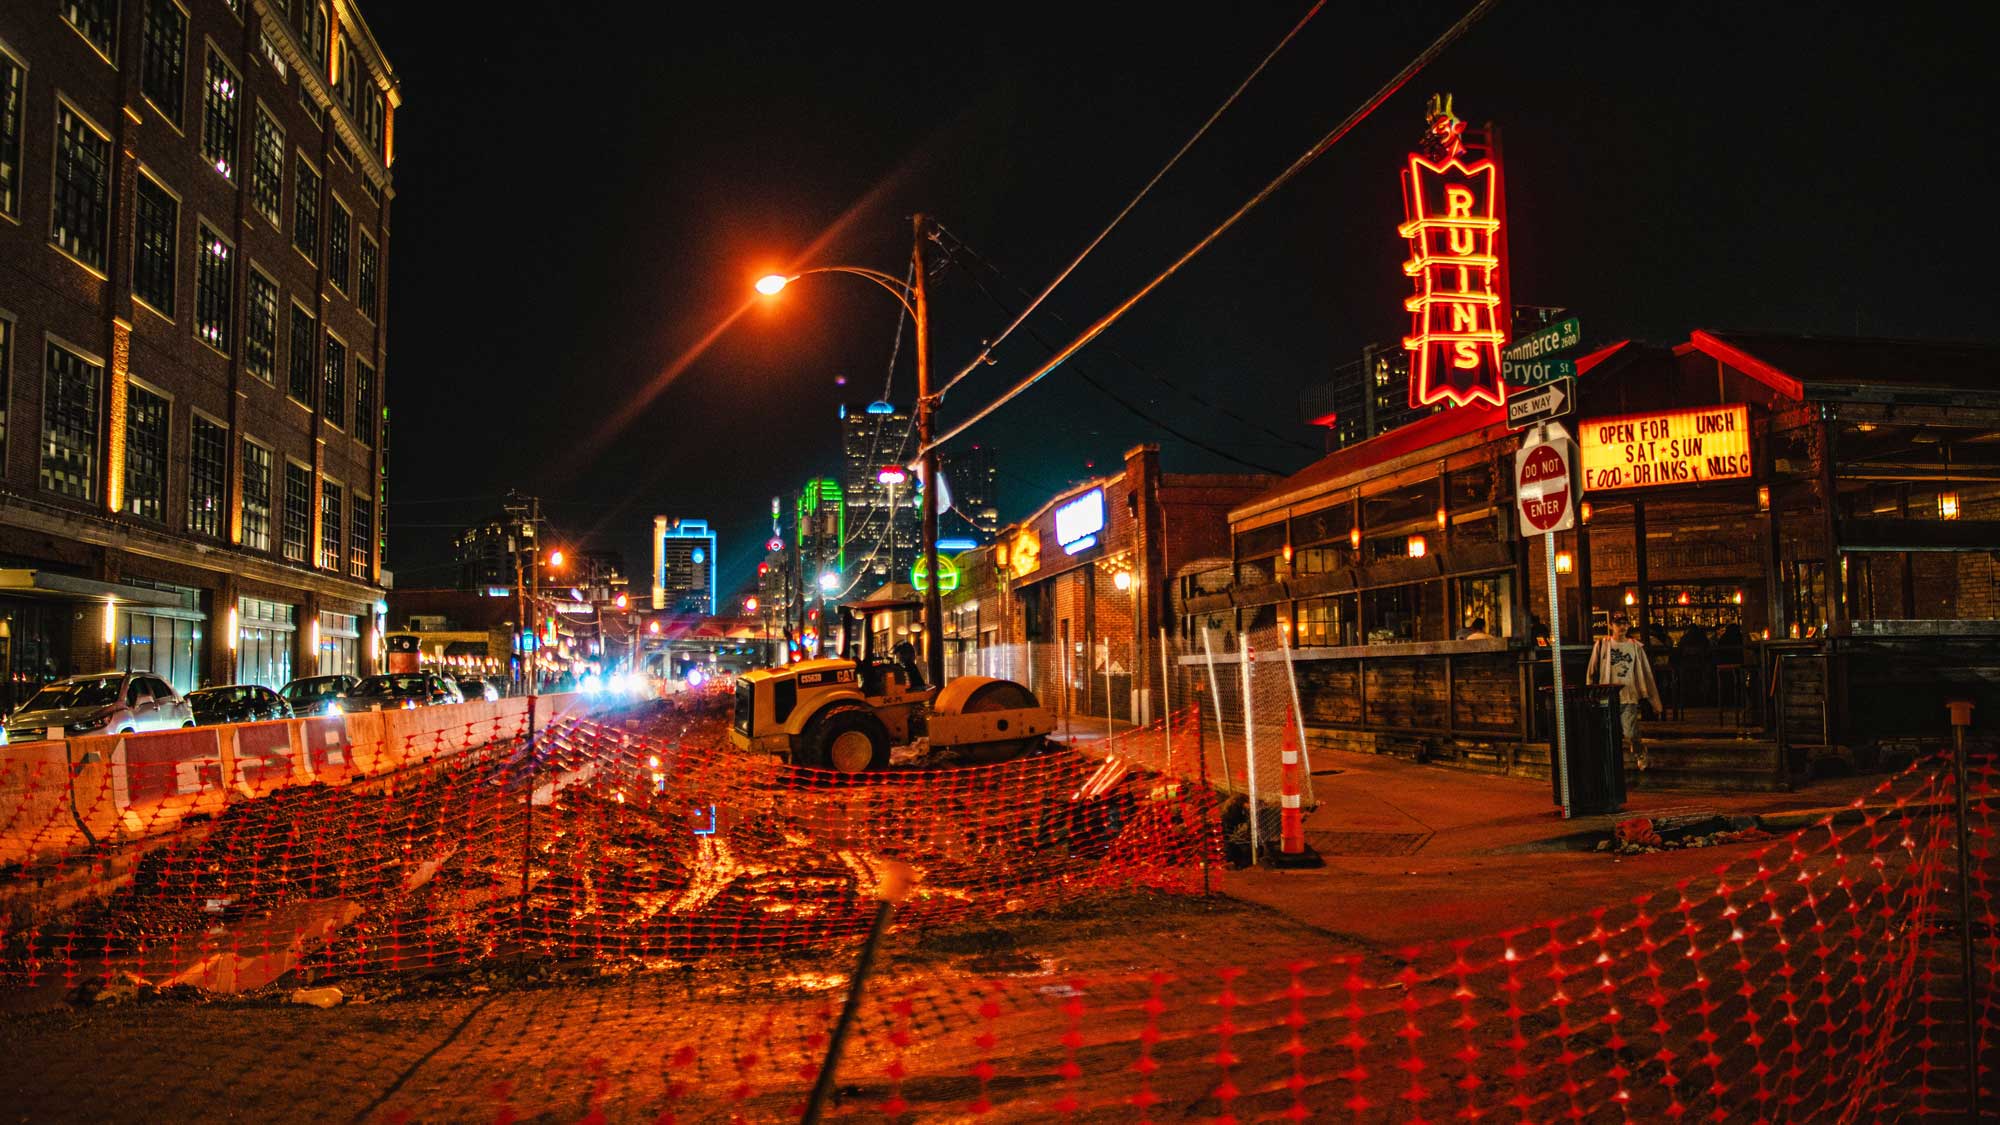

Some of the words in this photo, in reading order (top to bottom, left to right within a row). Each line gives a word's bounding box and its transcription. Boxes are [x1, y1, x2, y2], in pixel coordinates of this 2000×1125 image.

[1446, 186, 1480, 370] RUINS
[1564, 323, 1572, 334] St
[1502, 361, 1551, 384] Pryor
[1560, 362, 1569, 373] St
[1511, 405, 1528, 417] ONE
[1532, 395, 1551, 411] WAY
[1600, 424, 1634, 444] OPEN
[1640, 419, 1669, 441] FOR
[1626, 442, 1656, 463] SAT
[1671, 438, 1702, 459] SUN
[1525, 464, 1537, 478] DO
[1542, 458, 1559, 474] NOT
[1586, 467, 1621, 489] FOOD
[1633, 460, 1688, 484] DRINKS
[1530, 500, 1559, 517] ENTER
[836, 669, 856, 683] CAT
